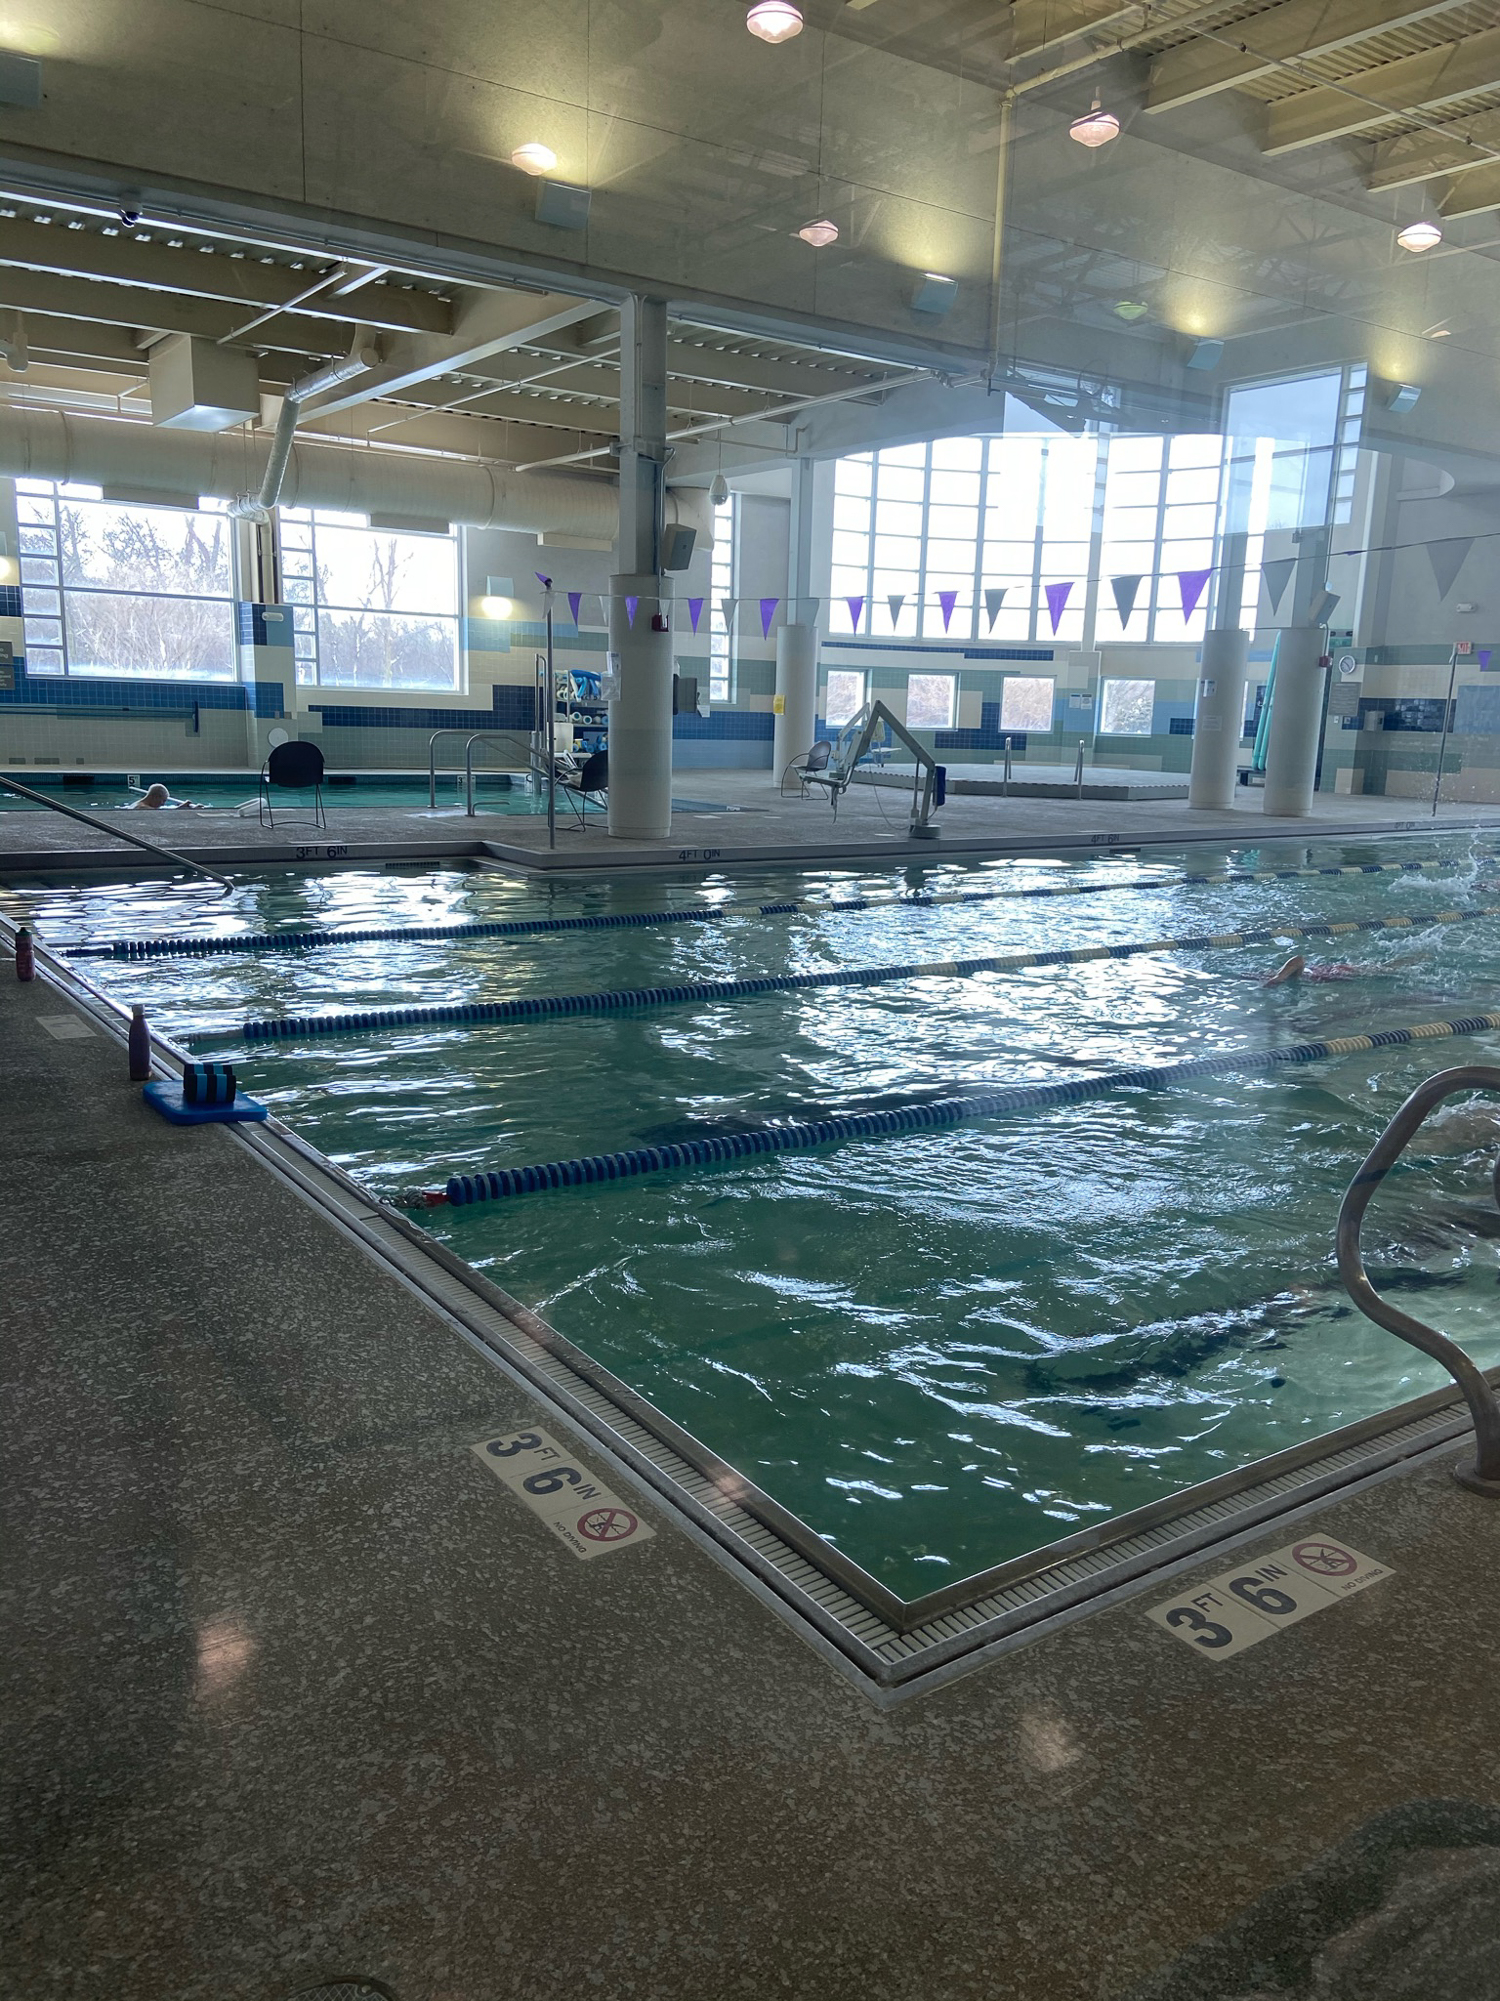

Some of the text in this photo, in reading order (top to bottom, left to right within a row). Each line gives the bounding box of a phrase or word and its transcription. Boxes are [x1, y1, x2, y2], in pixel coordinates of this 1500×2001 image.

[553, 1521, 587, 1553] NO DIVING
[1341, 1568, 1384, 1591] NO DIVING
